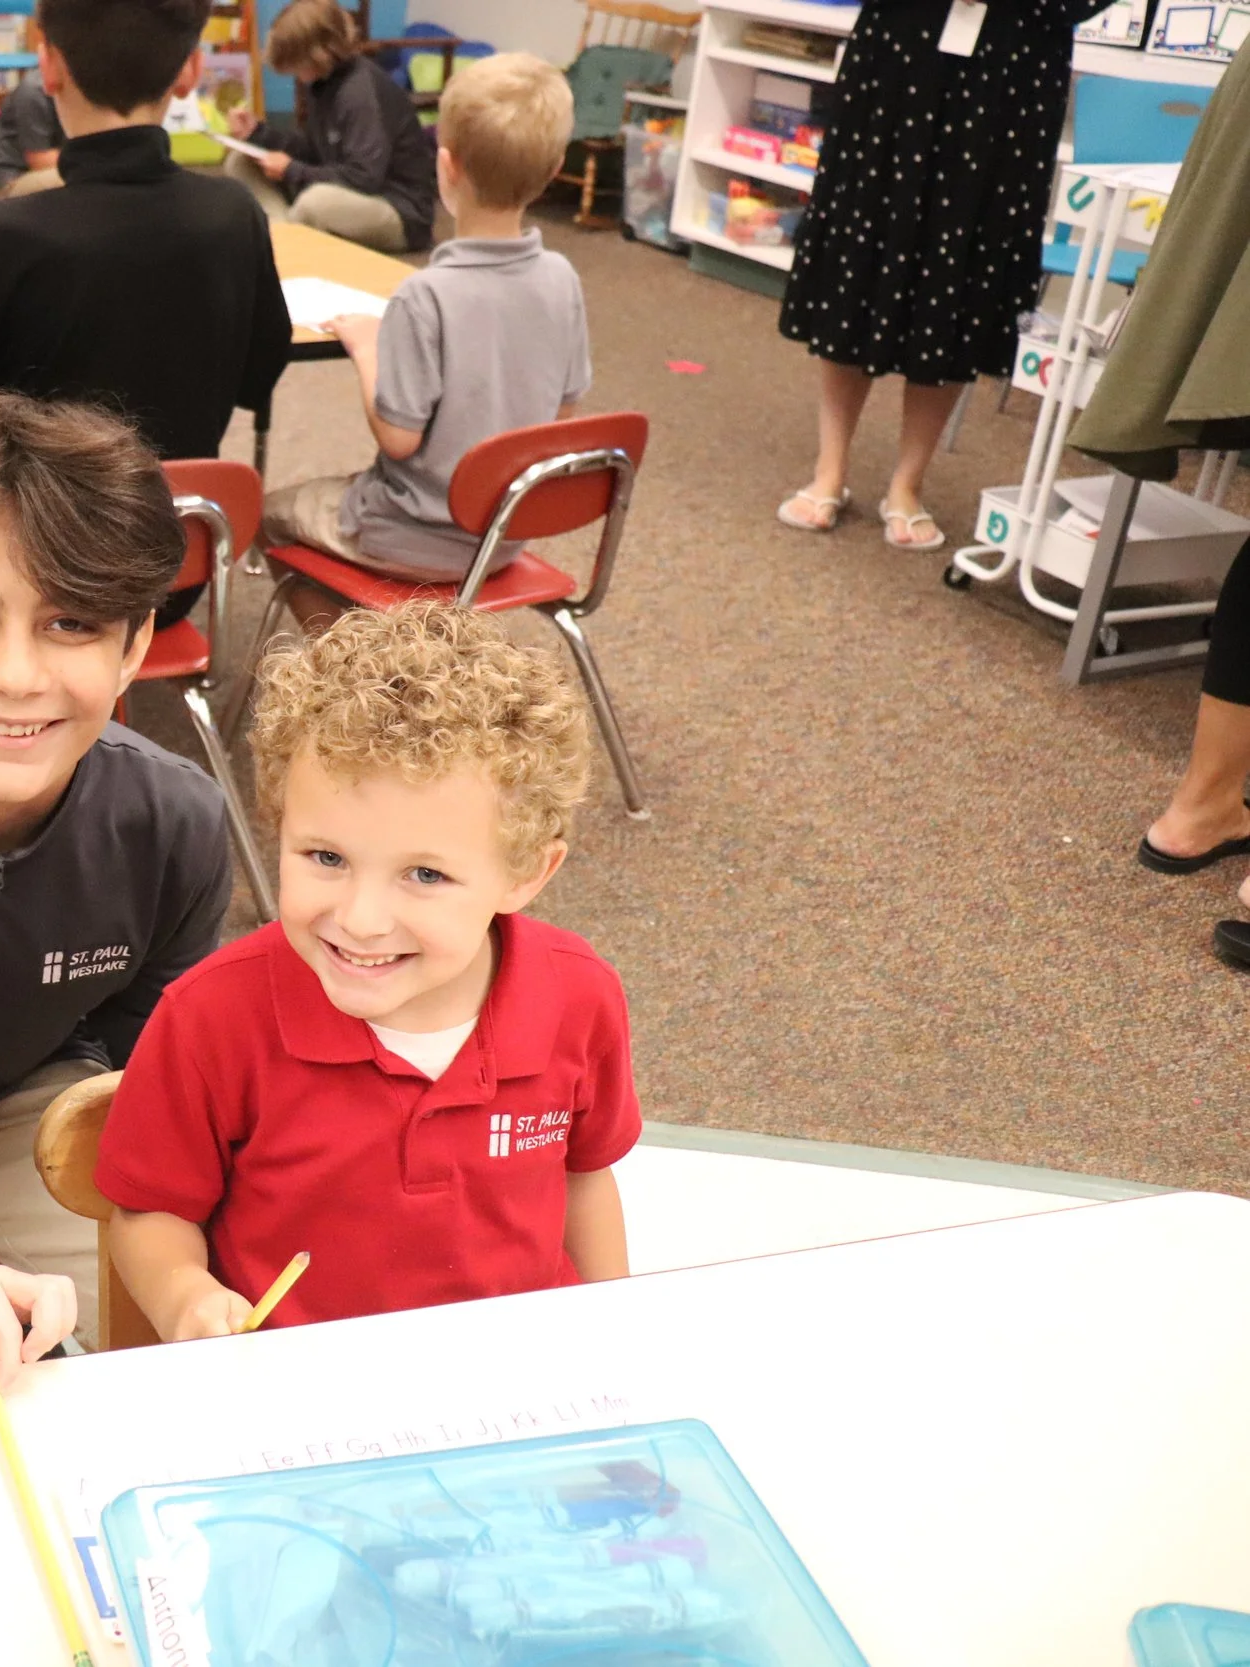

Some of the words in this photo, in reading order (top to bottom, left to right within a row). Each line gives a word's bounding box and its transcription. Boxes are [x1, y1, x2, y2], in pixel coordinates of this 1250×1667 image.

[69, 951, 90, 966] ST.
[92, 944, 131, 962] PAUL
[69, 960, 128, 981] WESTLAKE
[516, 1115, 536, 1133] ST.
[538, 1110, 570, 1131] PAUL
[516, 1128, 566, 1152] WESTLAKE
[261, 1451, 295, 1470] Ee
[305, 1441, 333, 1464] Ff
[346, 1438, 385, 1457] Gg
[392, 1430, 427, 1449] Hh
[510, 1410, 543, 1429] Kk
[147, 1576, 189, 1667] Anthon
